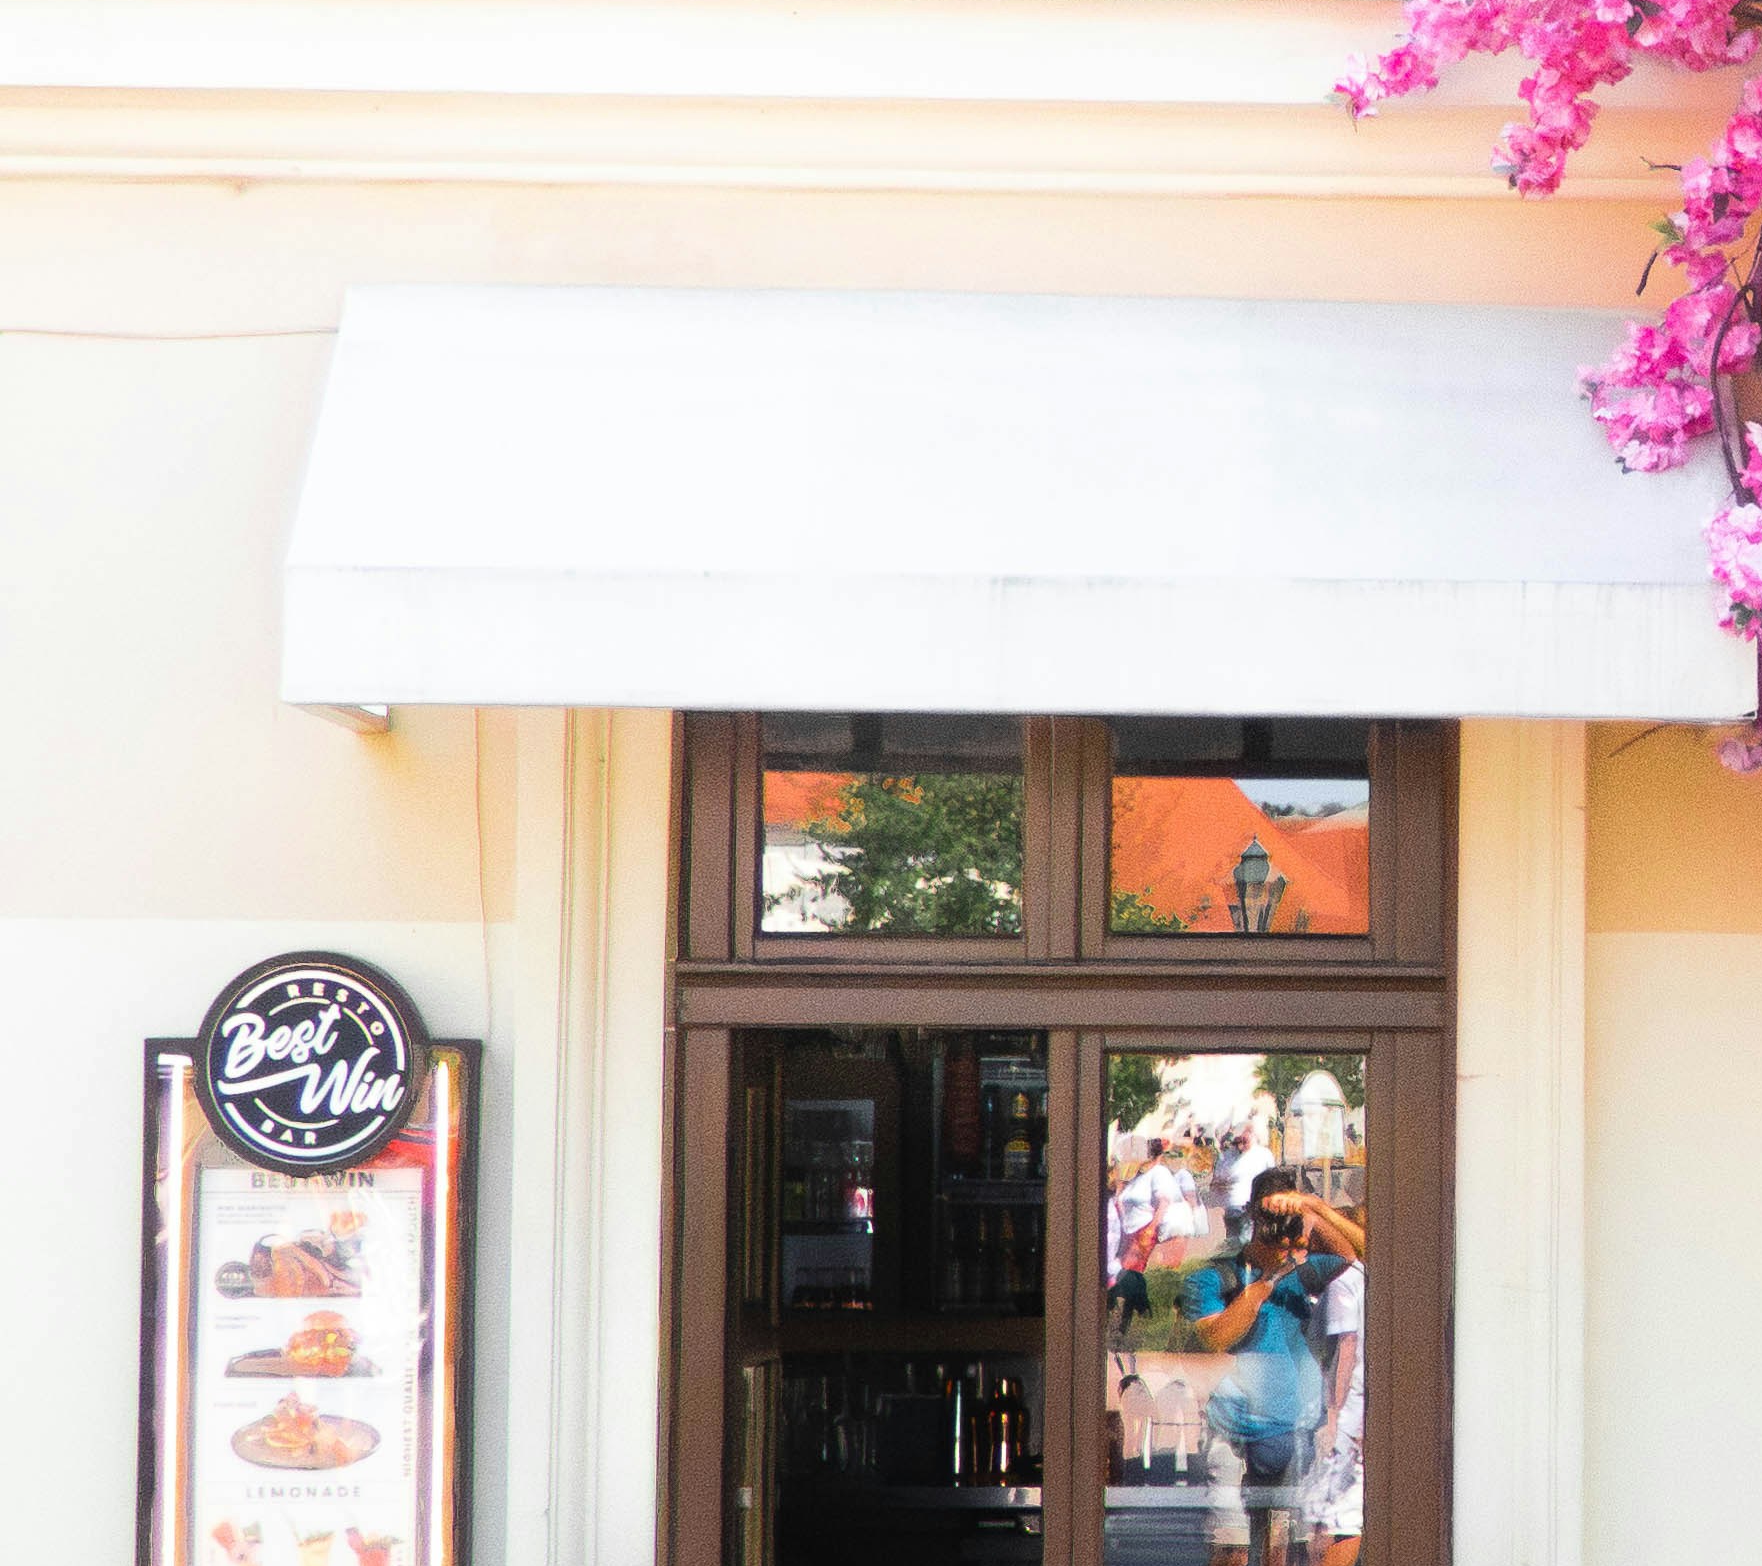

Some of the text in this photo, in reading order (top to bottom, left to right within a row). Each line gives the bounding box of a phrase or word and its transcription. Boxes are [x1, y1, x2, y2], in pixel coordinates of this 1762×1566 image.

[286, 982, 385, 1036] RESTO
[221, 1003, 341, 1079] Best
[217, 1046, 405, 1116] Win
[260, 1118, 317, 1145] BAR
[246, 1486, 362, 1498] LEMONADE
